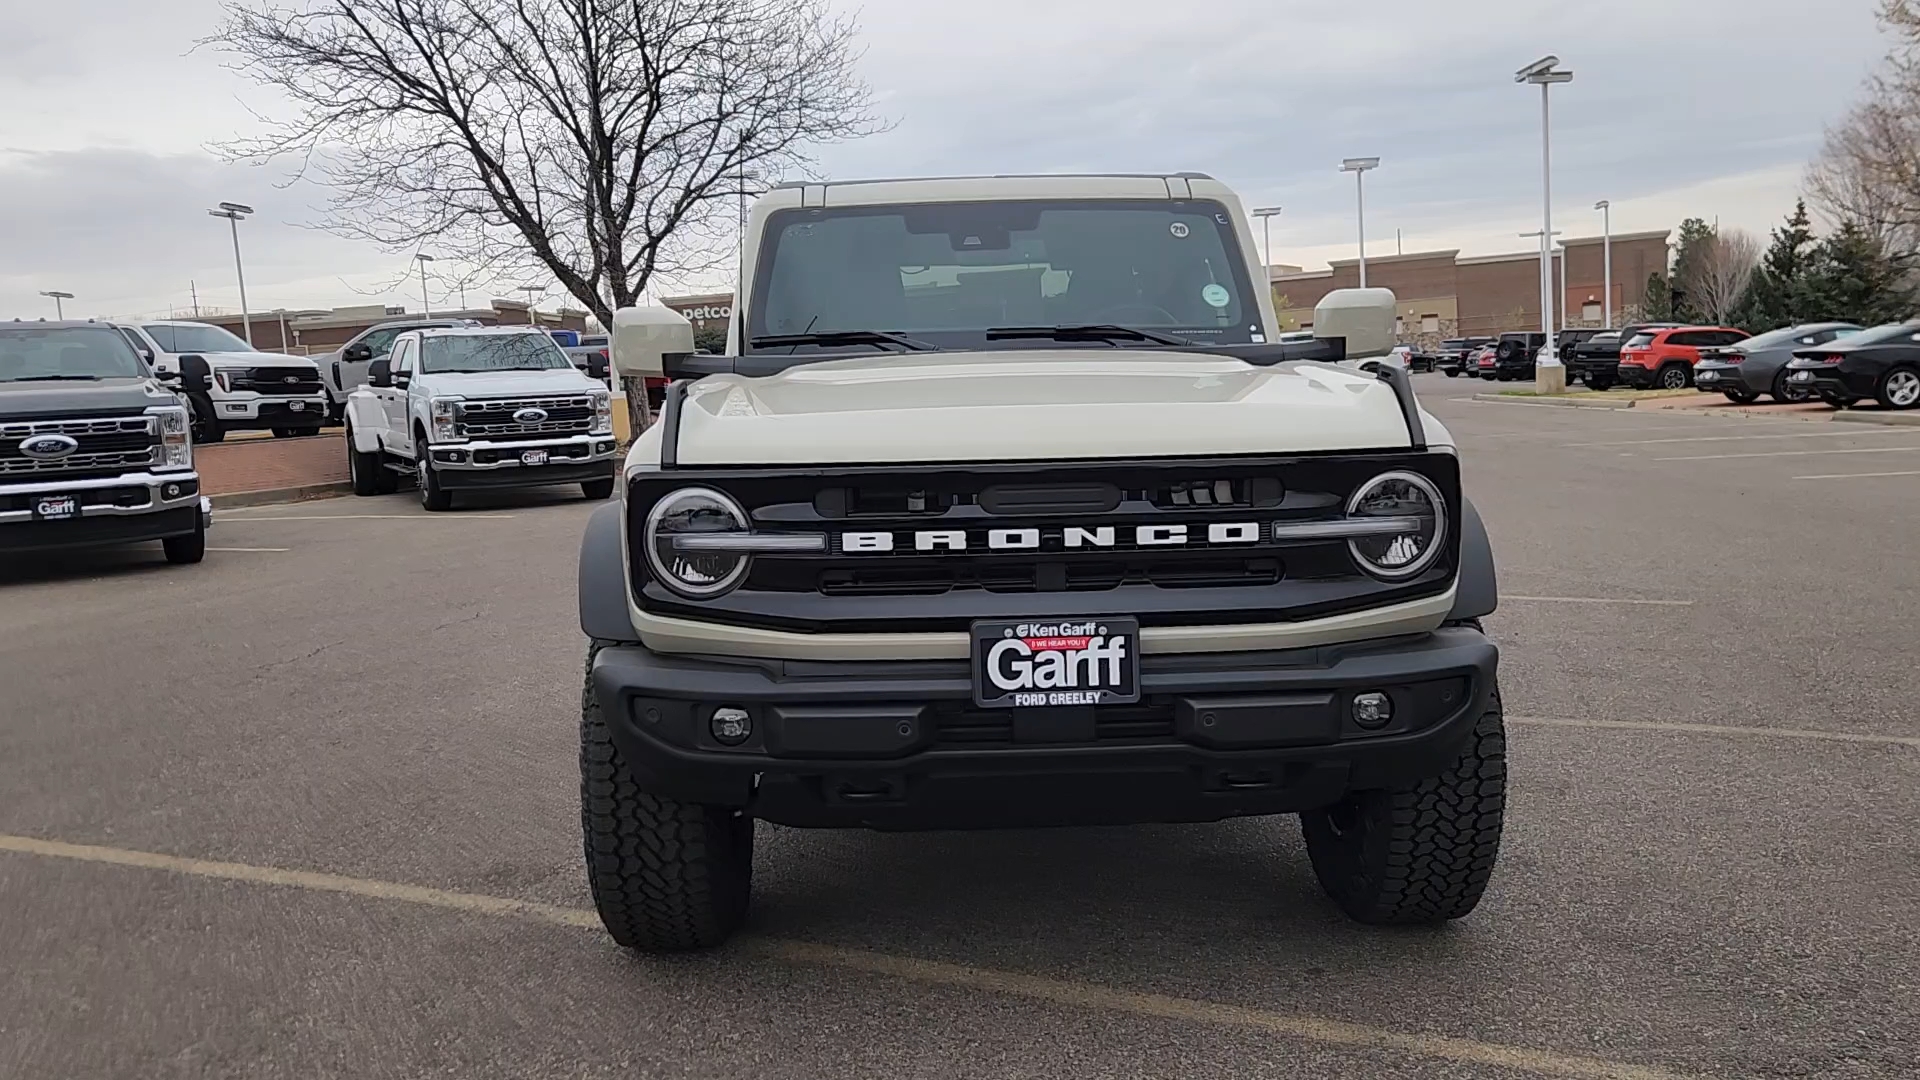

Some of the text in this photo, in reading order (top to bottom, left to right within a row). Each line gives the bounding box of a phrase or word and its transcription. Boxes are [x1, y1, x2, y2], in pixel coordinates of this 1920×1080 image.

[682, 305, 731, 320] petco
[35, 440, 62, 452] Ford
[521, 451, 548, 463] Garff
[38, 500, 75, 515] Garff
[841, 522, 1259, 551] BRONCO
[1029, 622, 1097, 637] Ken Garff
[1066, 639, 1081, 647] YOU
[987, 636, 1125, 690] Garff
[1015, 691, 1101, 706] FORD GREELEY
